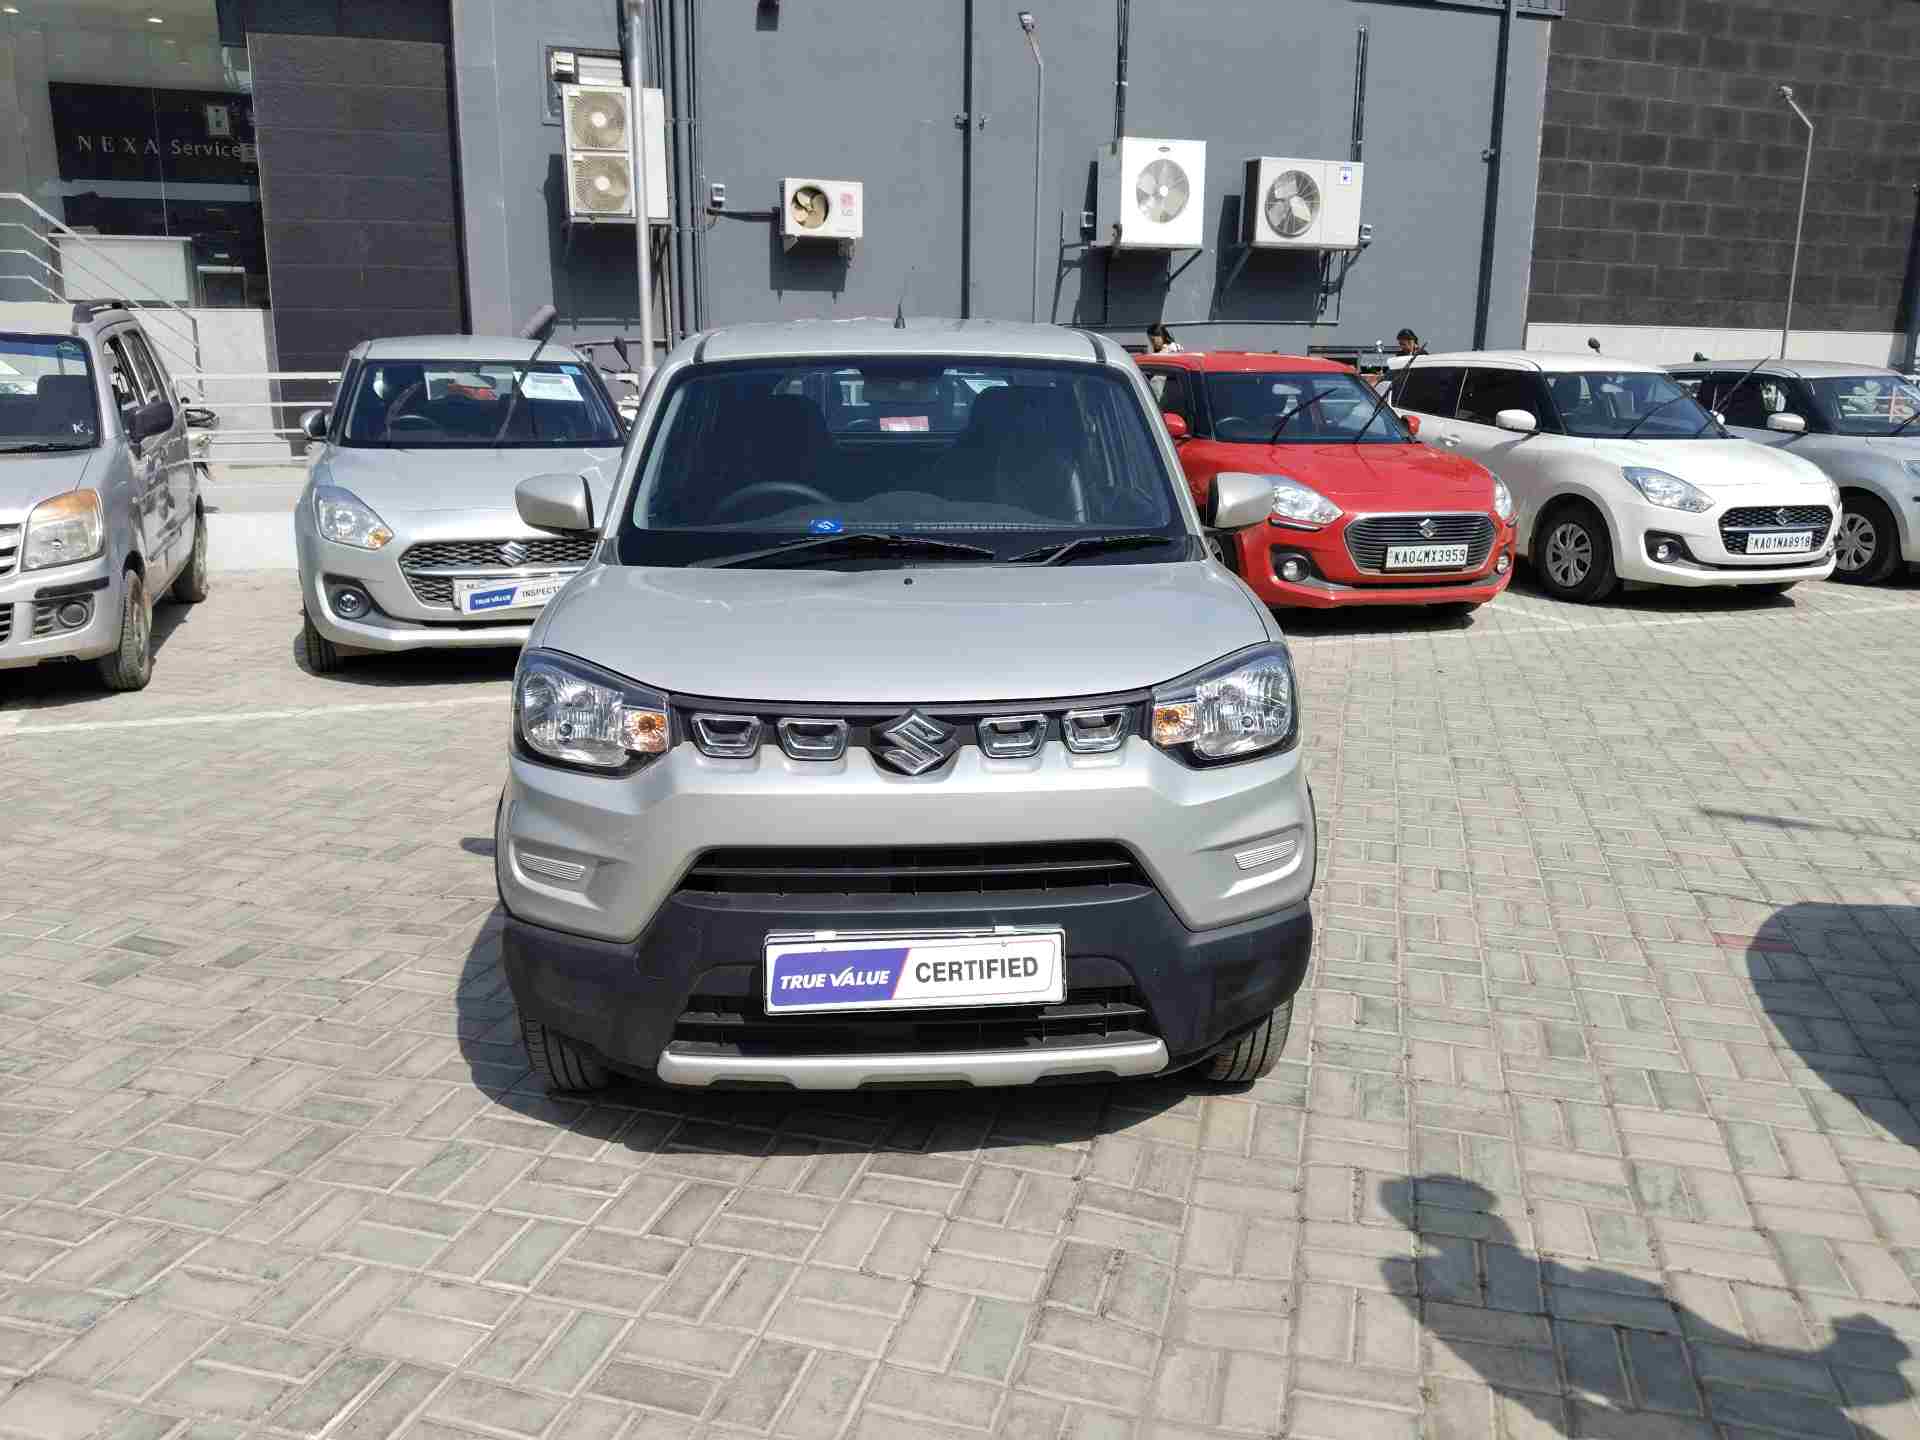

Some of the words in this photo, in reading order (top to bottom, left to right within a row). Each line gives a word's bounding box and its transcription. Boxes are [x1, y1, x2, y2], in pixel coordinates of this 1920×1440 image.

[78, 135, 160, 154] NEXA
[170, 138, 240, 157] Service
[779, 973, 825, 990] TRUE
[830, 966, 891, 988] VALUE
[915, 956, 1038, 983] CERTIFIED
